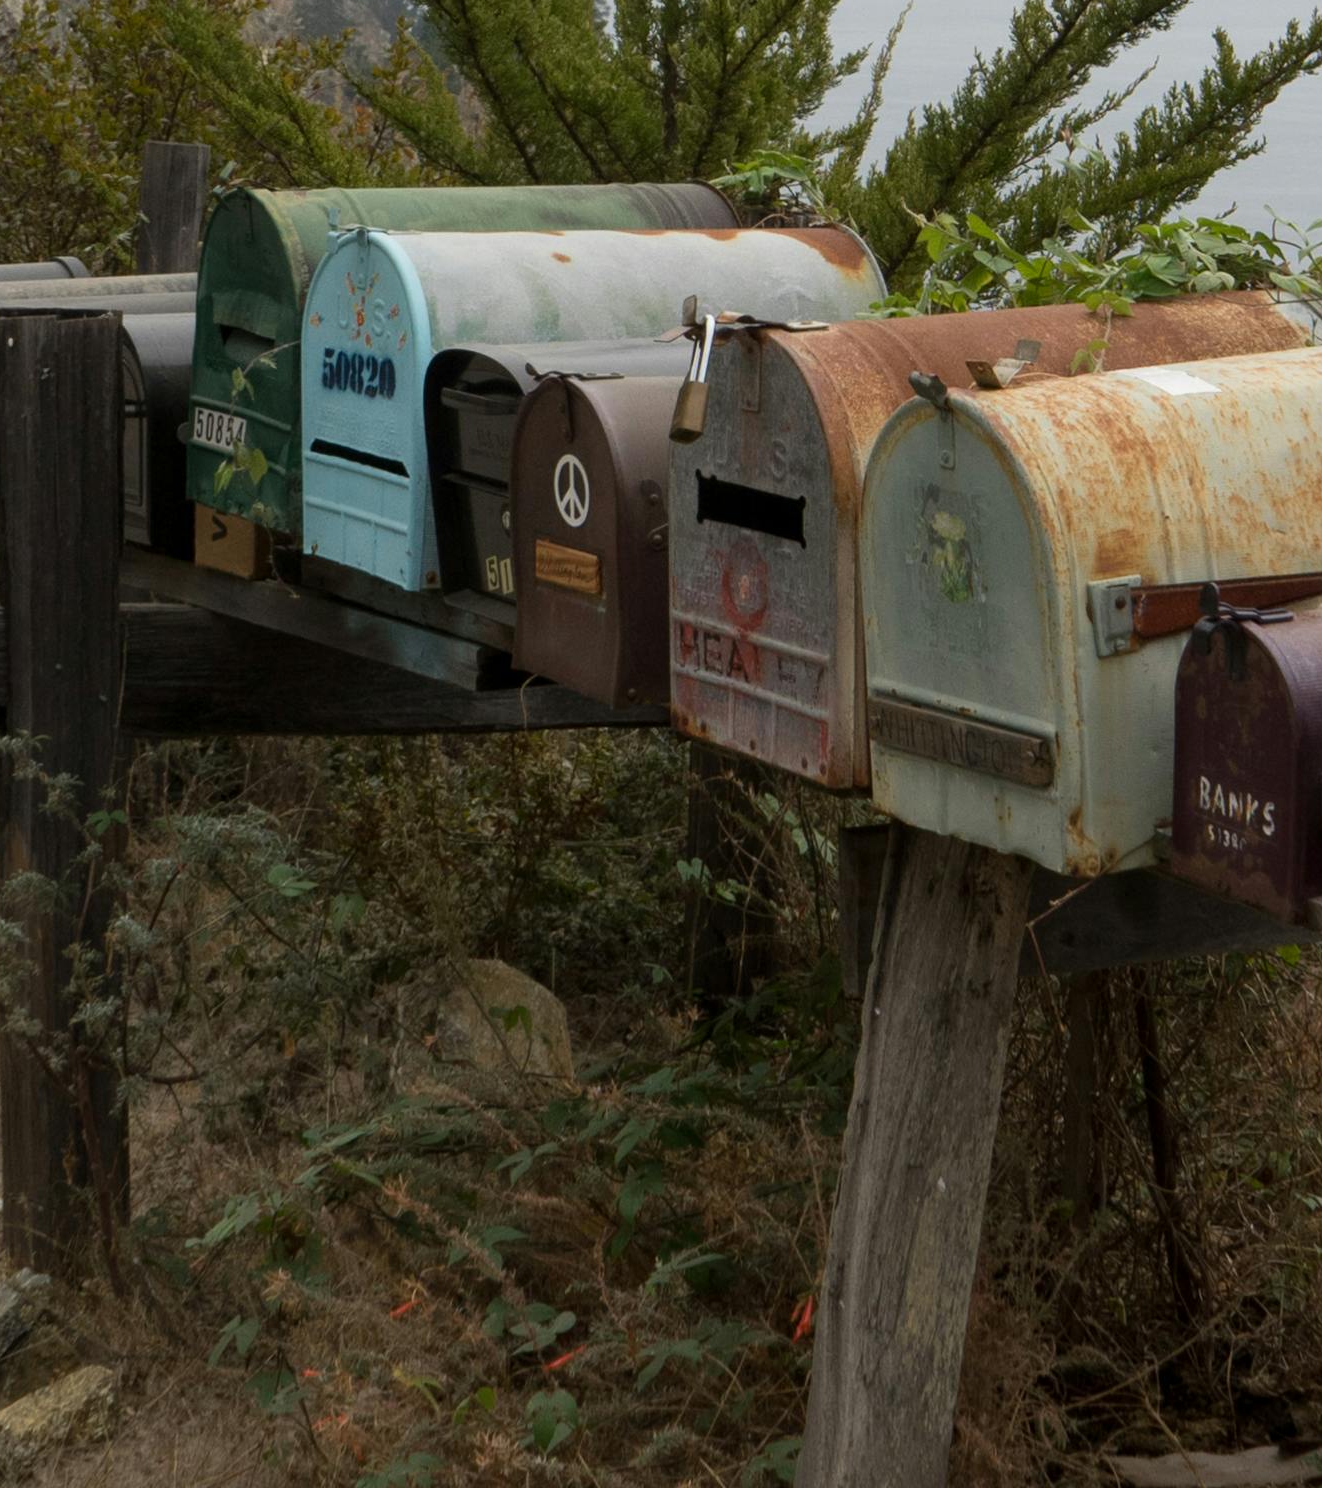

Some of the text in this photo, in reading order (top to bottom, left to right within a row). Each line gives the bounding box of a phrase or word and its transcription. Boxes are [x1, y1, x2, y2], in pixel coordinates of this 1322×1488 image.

[321, 347, 396, 400] 50820
[196, 410, 245, 446] 50854
[1199, 775, 1277, 838] BANKS
